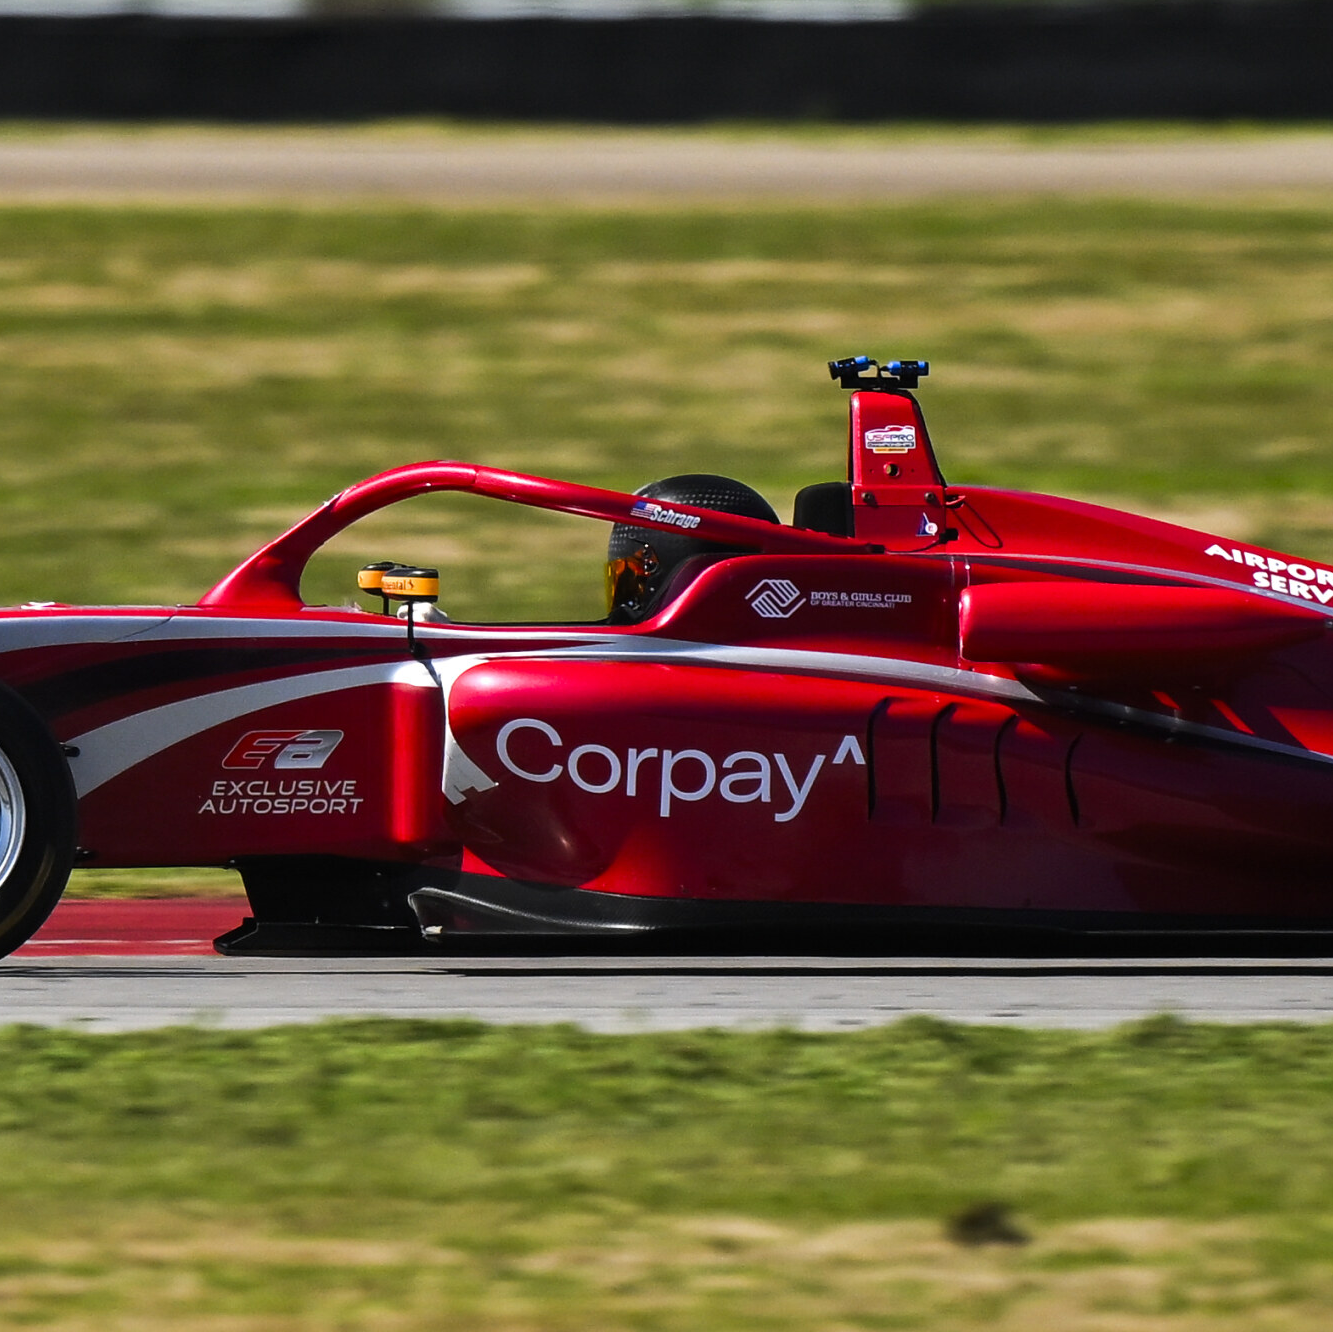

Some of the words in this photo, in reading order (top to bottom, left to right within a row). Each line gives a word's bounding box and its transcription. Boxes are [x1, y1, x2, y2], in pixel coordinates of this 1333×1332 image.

[649, 506, 701, 529] Schrage
[810, 591, 838, 601] BOYS
[840, 592, 849, 602] &
[851, 592, 882, 603] GIRLS
[884, 594, 912, 604] CLUB
[212, 780, 357, 796] EXCLUSIVE
[198, 798, 364, 814] AUTOSPORT
